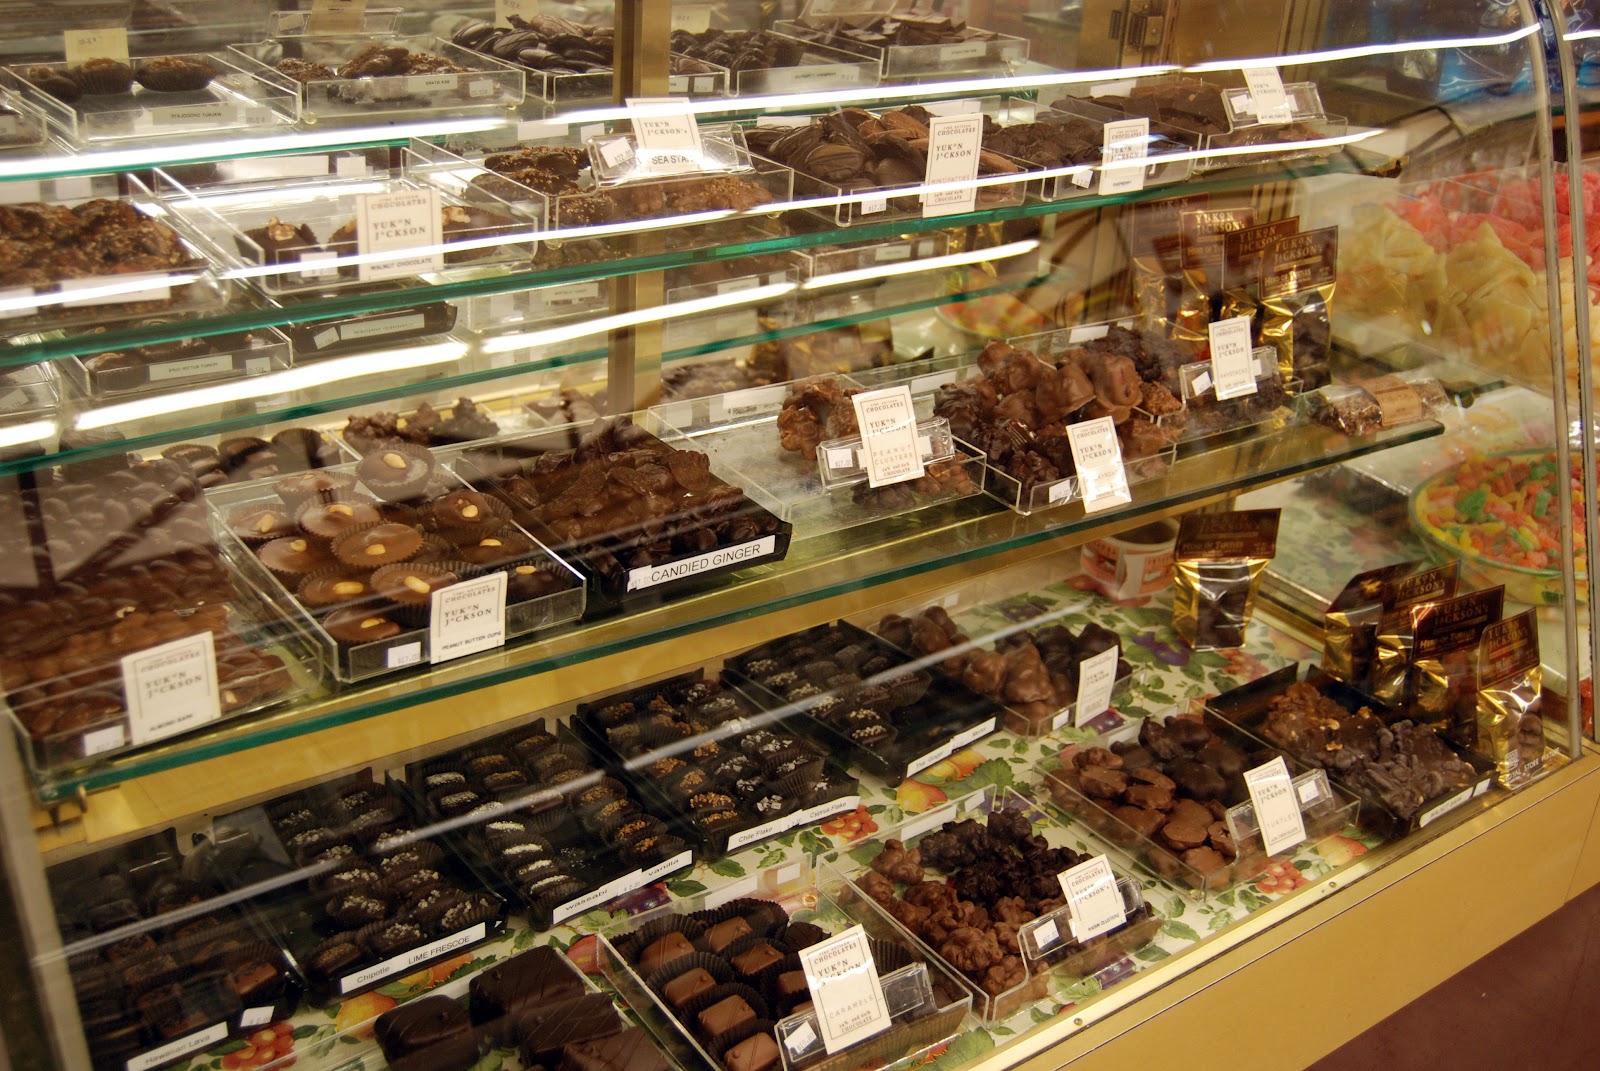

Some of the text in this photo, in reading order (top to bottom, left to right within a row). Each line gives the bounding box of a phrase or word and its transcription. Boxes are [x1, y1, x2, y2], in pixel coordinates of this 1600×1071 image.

[937, 127, 976, 137] CHOCOLATES
[936, 143, 963, 152] YUKON
[936, 150, 972, 160] JACKSON
[652, 155, 669, 165] SEA
[371, 199, 427, 210] CHOCOLATES
[373, 218, 411, 230] YUKON
[1196, 212, 1233, 224] YUKON
[375, 226, 426, 240] JACKSON
[1240, 226, 1277, 242] YUKON
[1276, 236, 1313, 252] YUKON
[370, 258, 432, 271] WALNUT CHOCOLATE
[866, 401, 904, 413] CHOCOLATES
[869, 417, 896, 428] YUKON
[1076, 427, 1109, 439] CHOCOLATES
[873, 444, 912, 457] PEANUT
[1080, 443, 1103, 454] YUKON
[1082, 449, 1112, 462] JACKSON
[874, 452, 914, 465] CLUSTERS
[883, 468, 911, 477] CHOCOLATE
[651, 558, 709, 583] CANDIED
[712, 543, 761, 566] GINGER
[445, 586, 497, 604] CHOCOLATES
[444, 603, 480, 619] YUKON
[445, 608, 492, 627] JACKSON
[442, 630, 502, 650] PEANUT BUTTER CUPS
[145, 671, 187, 689] YUKON
[147, 674, 203, 700] JACKSON
[1257, 783, 1278, 796] YUKON
[1260, 787, 1288, 804] JACKSON
[809, 801, 847, 819] Cyprus Flake
[738, 827, 773, 843] Chile Flake
[565, 888, 608, 911] wassabi
[648, 858, 679, 876] vanilla
[1071, 868, 1104, 887] CHOCOLATES
[1101, 912, 1120, 927] CLUSTERS
[356, 935, 471, 984] Chipotle LIME FRESCOE
[814, 942, 857, 965] CHOCOLATES
[818, 959, 849, 977] YUKON
[829, 995, 875, 1020] CARAMELS
[841, 1016, 873, 1033] CHOCOLATE
[188, 1035, 211, 1048] Lava
